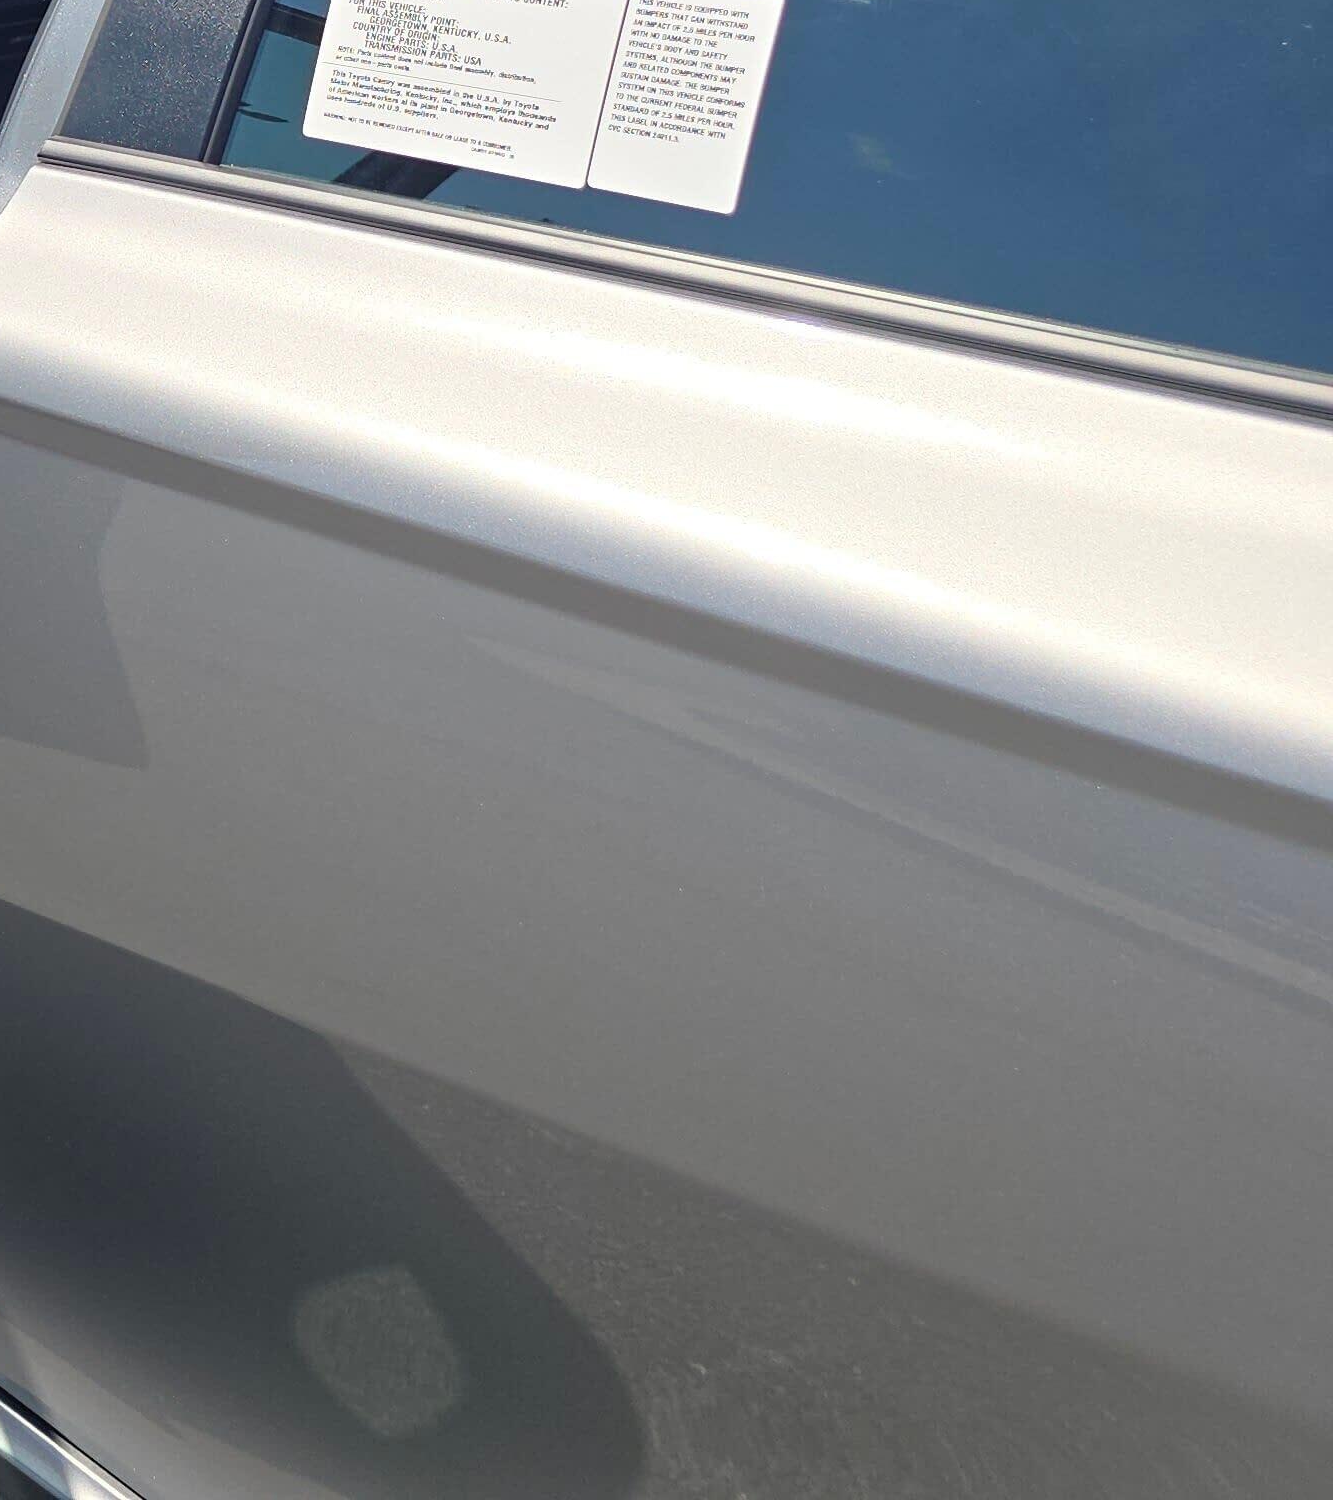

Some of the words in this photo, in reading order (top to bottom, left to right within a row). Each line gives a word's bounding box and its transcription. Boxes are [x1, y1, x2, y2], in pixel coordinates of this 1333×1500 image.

[357, 6, 379, 16] FINAL
[383, 10, 428, 23] ASSEMBLY
[431, 16, 459, 28] POINT:
[369, 0, 386, 9] THIS
[390, 2, 425, 14] VEHICLE:
[353, 22, 392, 35] COUNTRY
[395, 28, 405, 38] OF
[408, 30, 439, 41] ORIGIN:
[369, 16, 428, 33] GEORGETOWN,
[433, 26, 480, 40] KENTUCKY,
[485, 33, 511, 44] U.S.A.
[365, 40, 426, 56] TRANSMISSION
[430, 49, 461, 62] PARTS:
[464, 56, 481, 66] USA
[366, 32, 397, 43] ENGINE
[399, 37, 429, 49] PARTS:
[432, 42, 457, 53] U.S.A.
